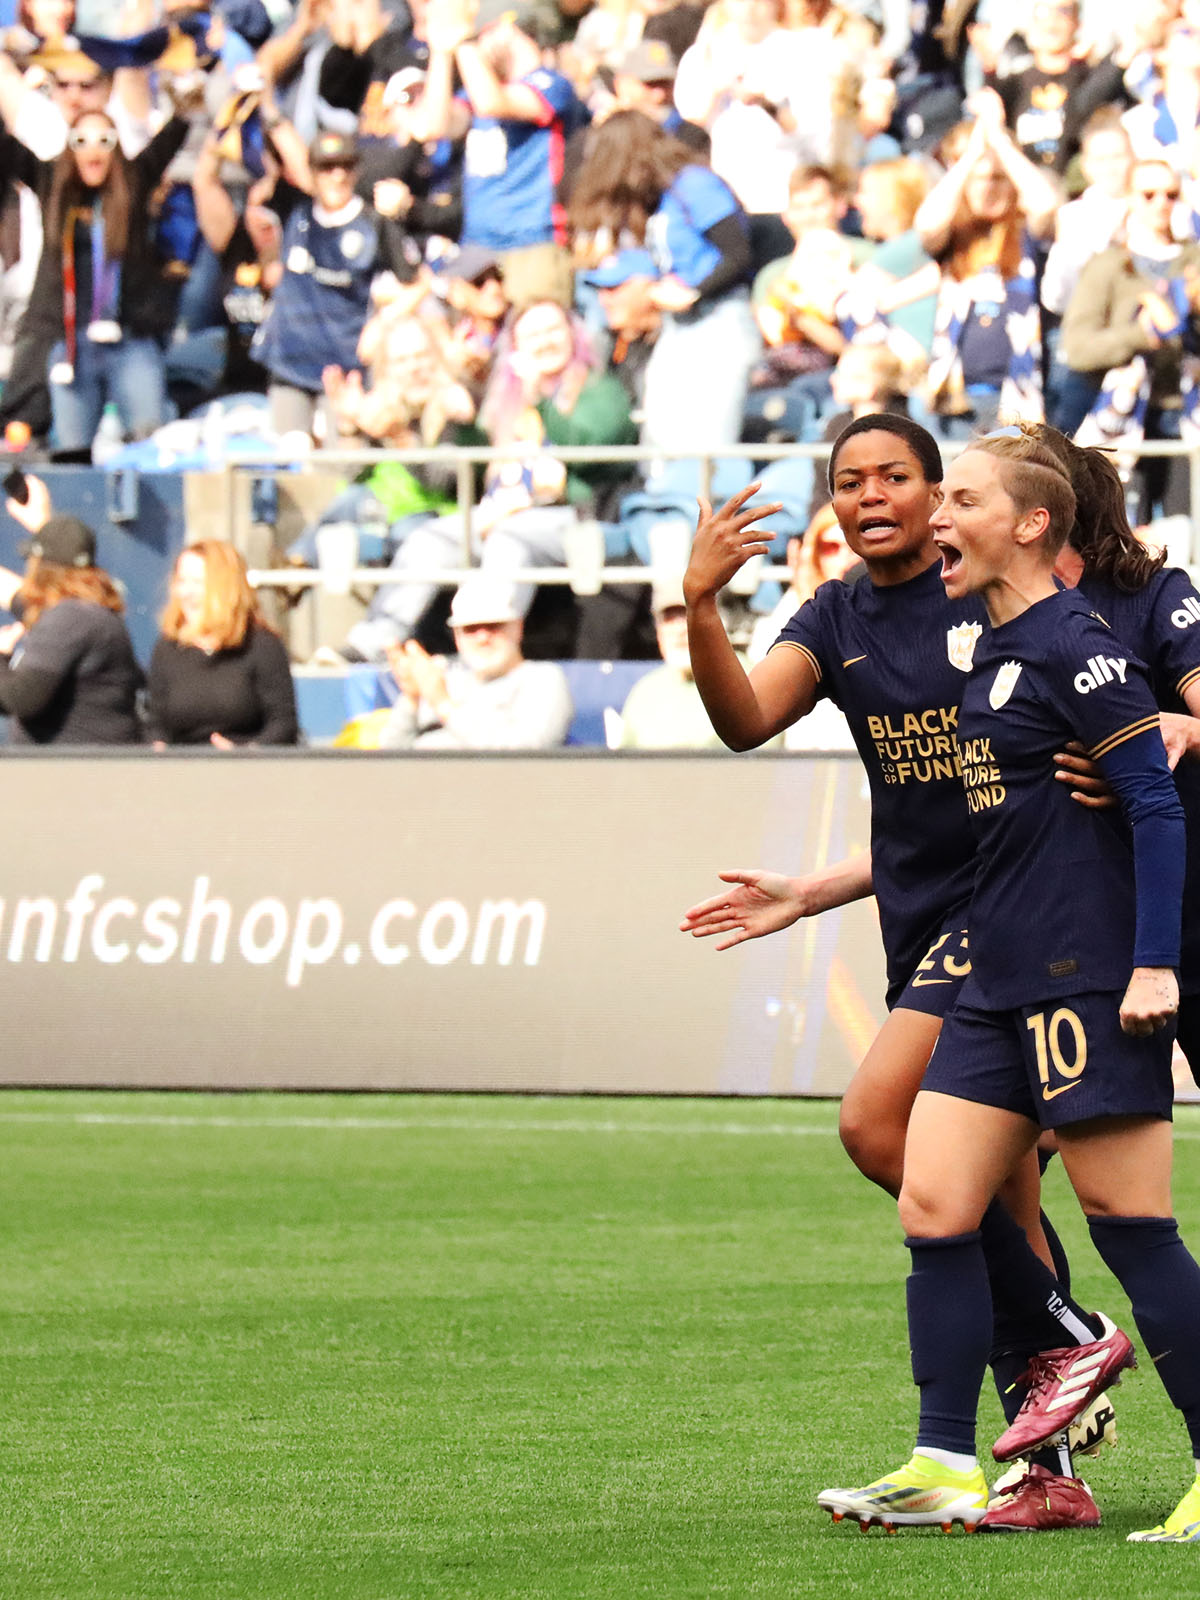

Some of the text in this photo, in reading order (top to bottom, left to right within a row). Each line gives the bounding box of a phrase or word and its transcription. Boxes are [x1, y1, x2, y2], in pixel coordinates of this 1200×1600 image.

[1074, 654, 1127, 695] ally
[867, 705, 959, 739] BLACK
[881, 762, 895, 773] CO
[956, 737, 996, 767] LACK
[884, 774, 898, 785] OP
[0, 872, 547, 987] nfcshop.com
[1026, 1007, 1089, 1085] 10
